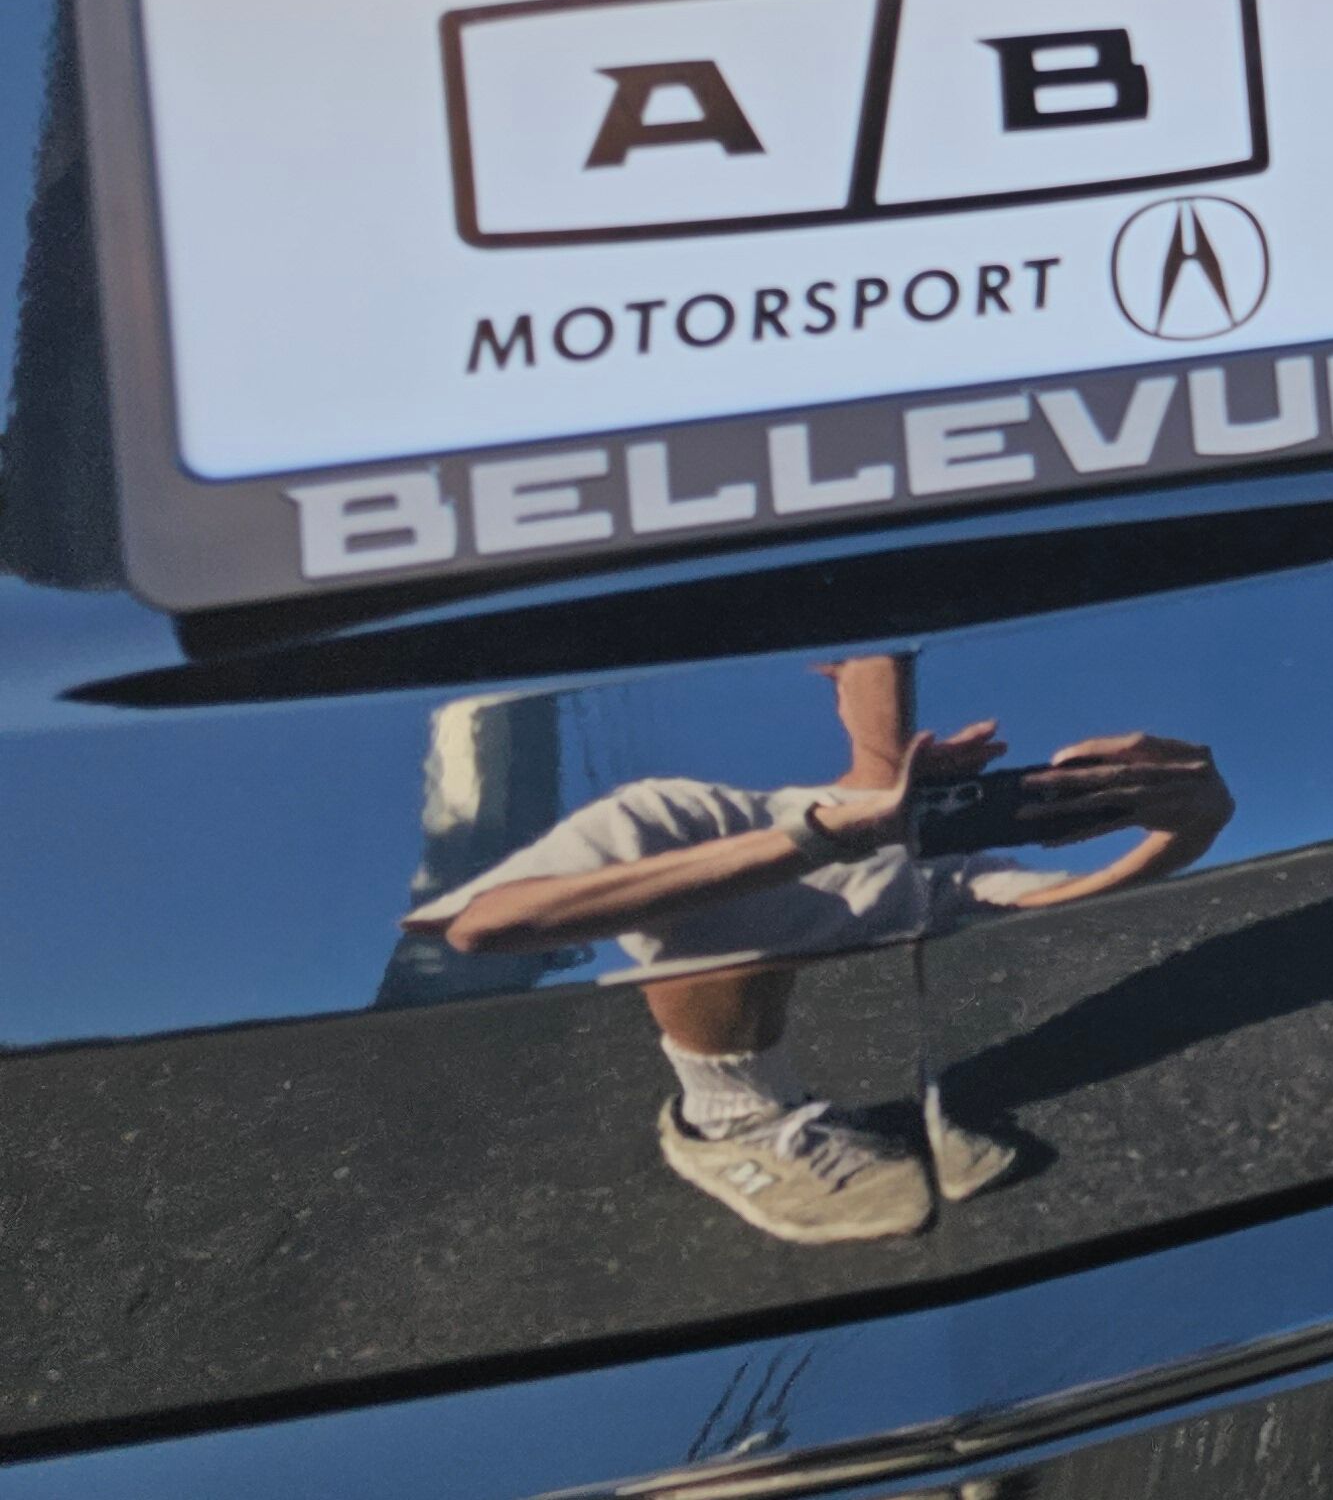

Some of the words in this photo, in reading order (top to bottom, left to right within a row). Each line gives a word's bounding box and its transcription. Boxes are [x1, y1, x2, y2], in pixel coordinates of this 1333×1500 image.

[583, 60, 766, 169] A
[980, 29, 1149, 133] B
[465, 257, 1062, 374] MOTORSPORT
